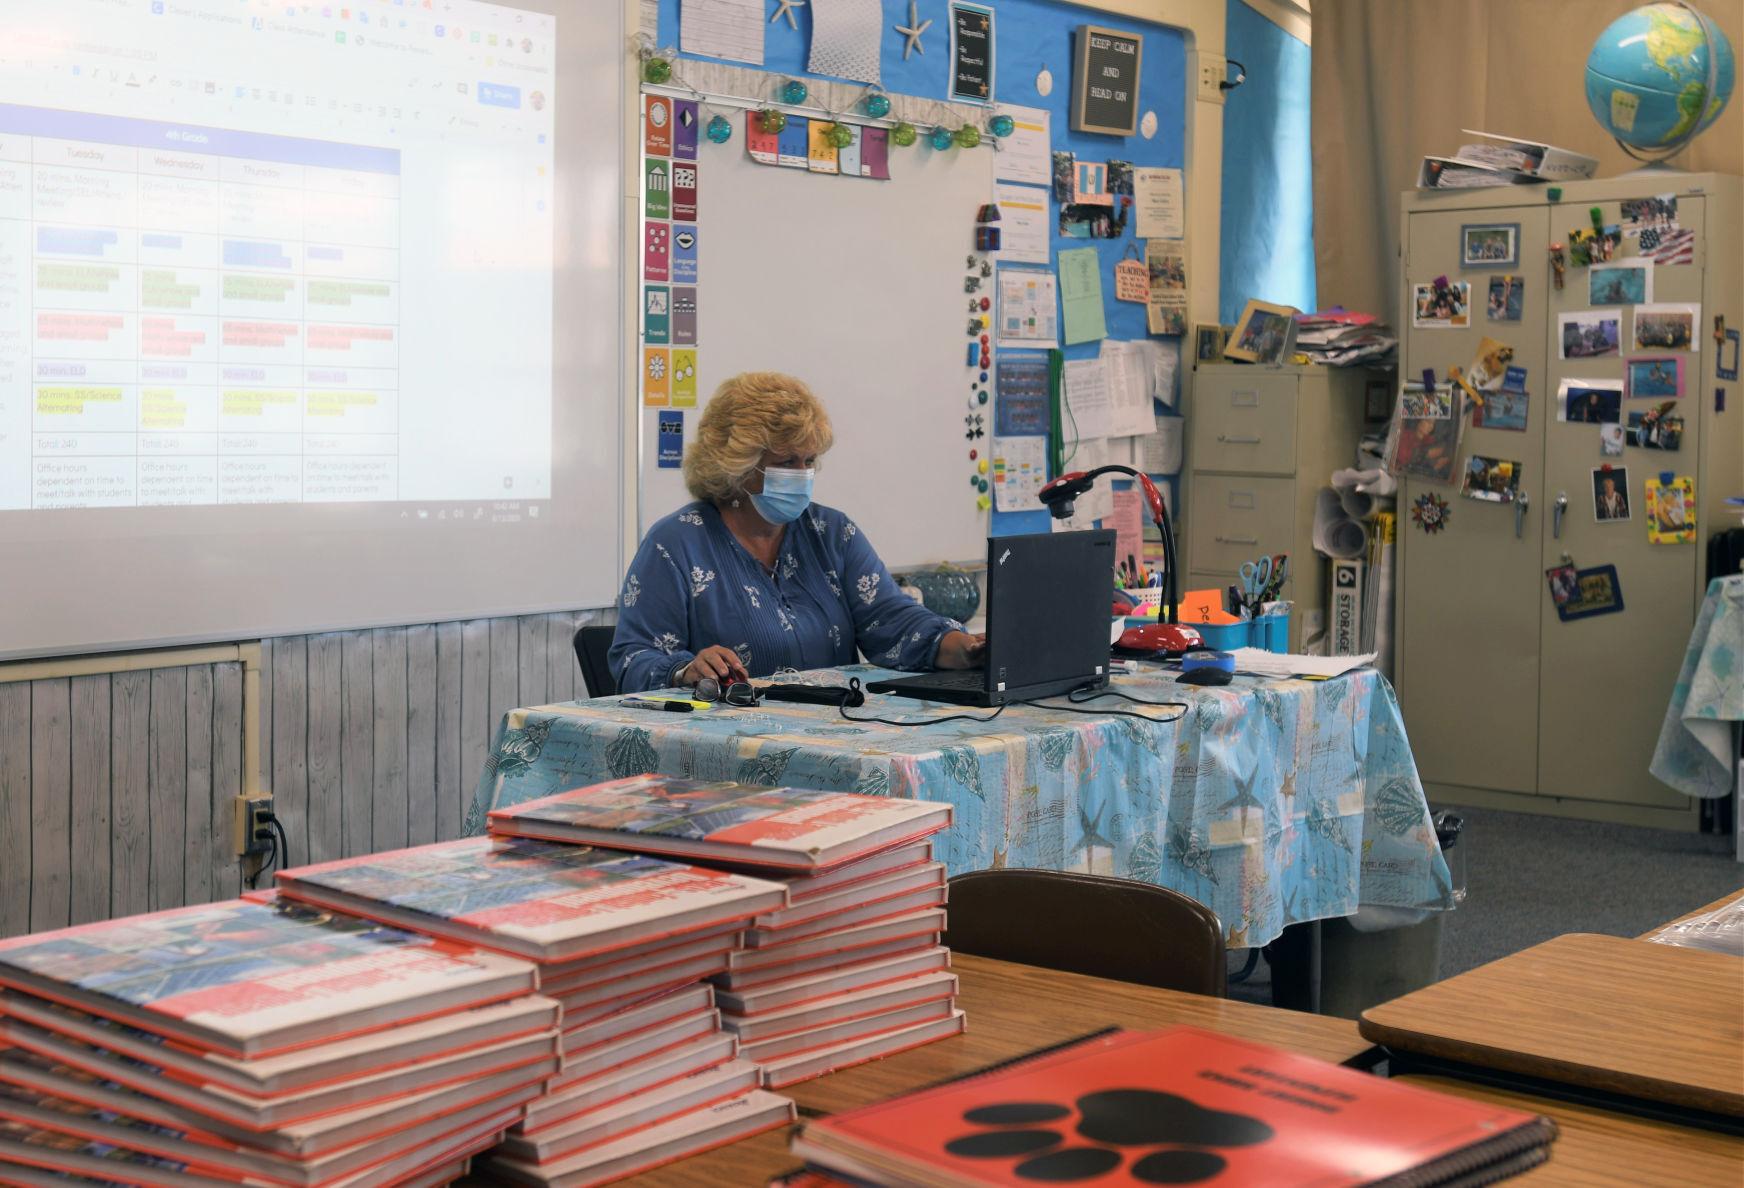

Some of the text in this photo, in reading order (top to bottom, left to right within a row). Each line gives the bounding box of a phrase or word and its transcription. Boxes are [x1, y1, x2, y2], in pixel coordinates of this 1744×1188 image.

[1091, 37, 1135, 55] KEEP CALM
[1103, 66, 1119, 78] AND
[1091, 87, 1127, 102] READ ON
[181, 130, 209, 143] Grade
[66, 146, 104, 162] Tuesday
[154, 156, 205, 173] Wednesday
[243, 165, 280, 181] Thursday
[61, 439, 77, 449] 240
[37, 463, 87, 473] Office hours
[141, 462, 189, 472] Office hours
[222, 462, 267, 471] Office hours
[306, 461, 386, 472] Office hours dependent
[37, 476, 82, 487] dependent
[96, 476, 115, 484] time
[116, 476, 125, 485] to
[141, 475, 184, 486] dependent
[197, 475, 214, 484] time
[222, 474, 263, 484] dependent
[274, 473, 290, 482] time
[78, 488, 95, 497] with
[97, 488, 132, 497] students
[188, 487, 206, 496] with
[1338, 569, 1354, 583] 6
[1339, 594, 1350, 655] STORAGE
